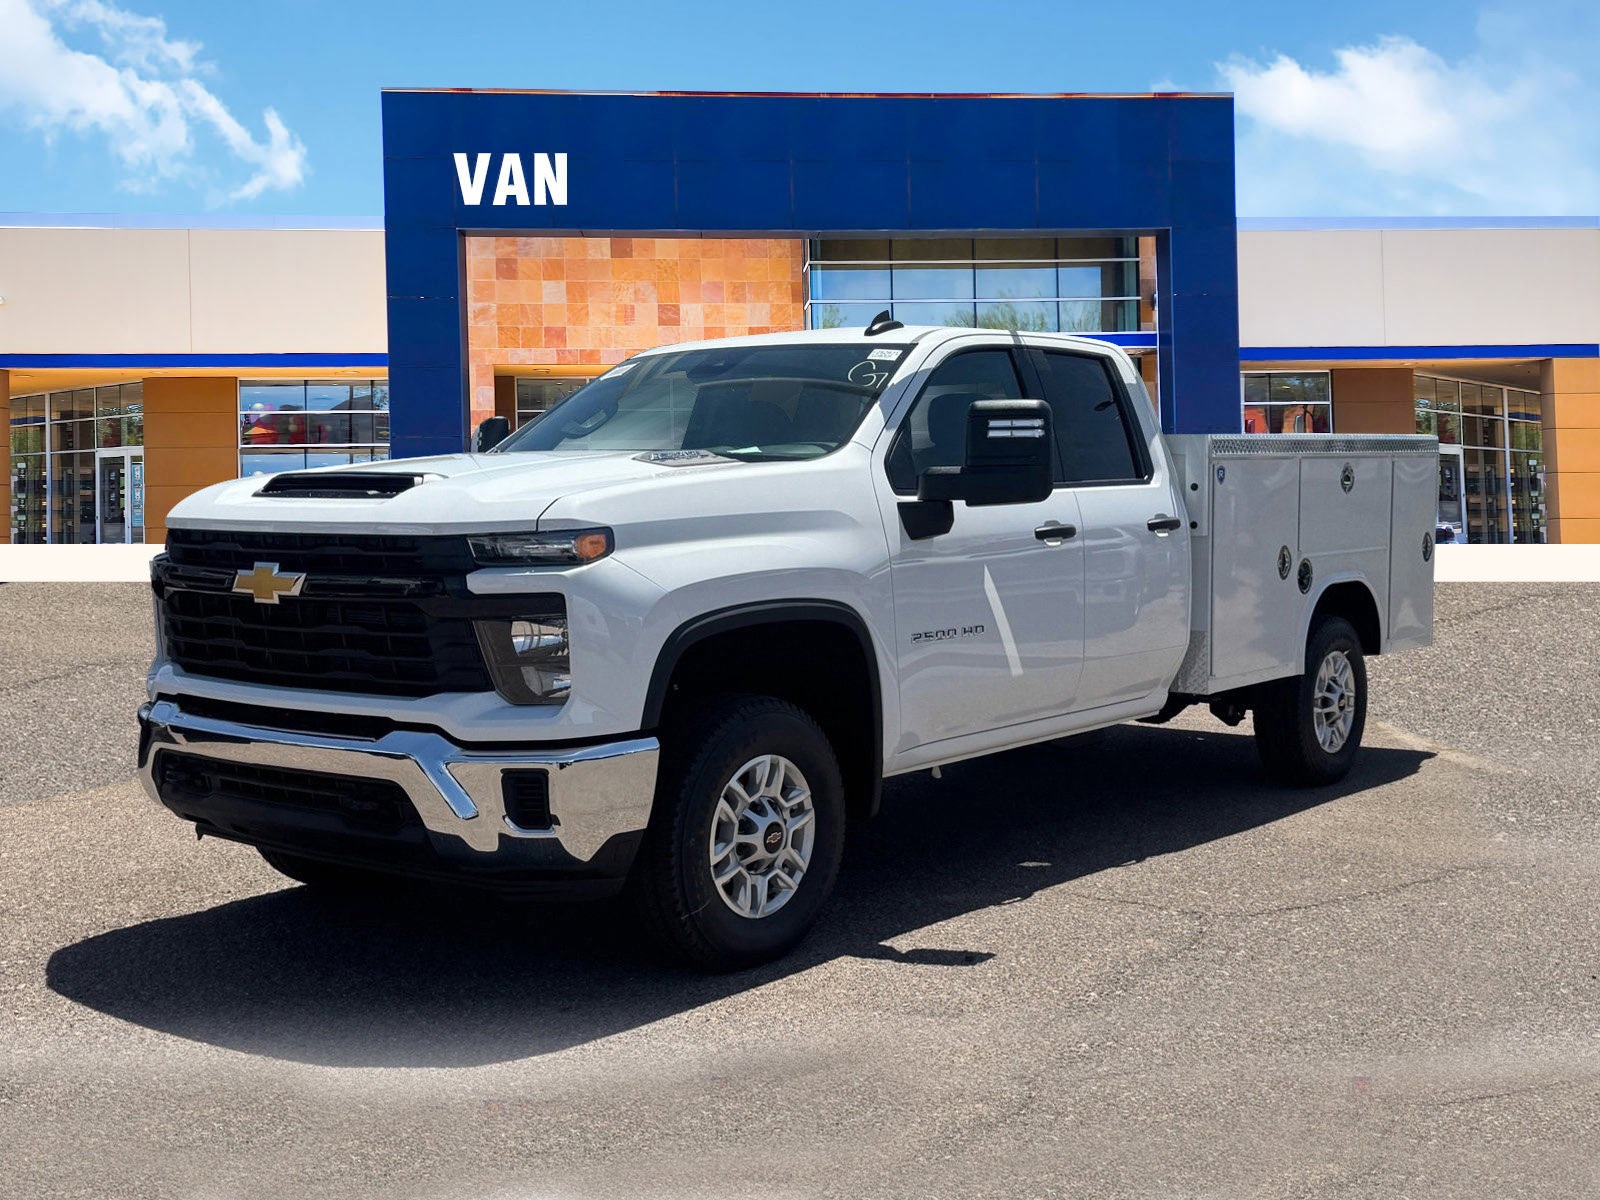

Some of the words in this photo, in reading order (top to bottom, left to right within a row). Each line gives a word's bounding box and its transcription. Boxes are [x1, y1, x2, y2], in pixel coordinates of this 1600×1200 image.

[453, 153, 568, 206] VAN
[910, 628, 957, 644] 2500
[961, 624, 985, 637] HD
